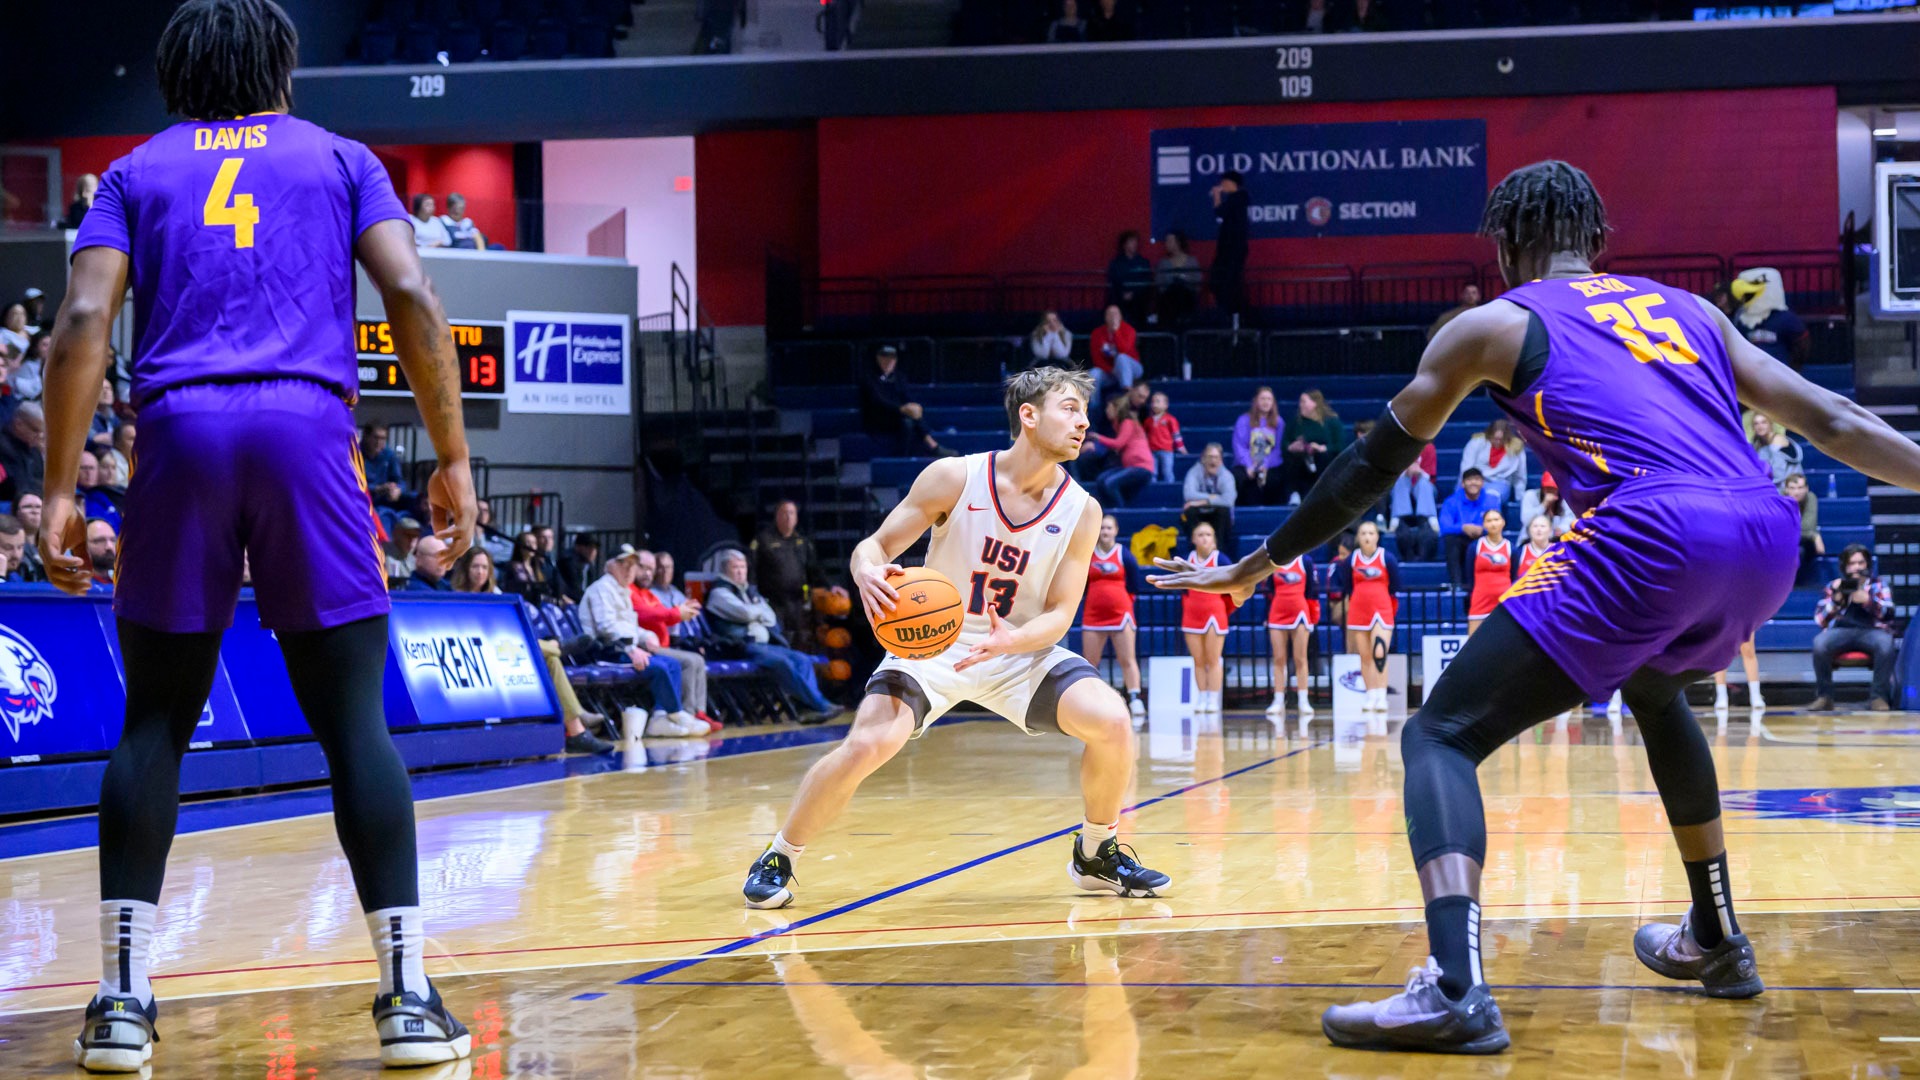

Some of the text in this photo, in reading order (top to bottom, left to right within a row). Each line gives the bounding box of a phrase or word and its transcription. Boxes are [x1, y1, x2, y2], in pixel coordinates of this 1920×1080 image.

[1276, 47, 1312, 69] 209
[410, 74, 445, 97] 209
[1279, 75, 1312, 97] 109
[195, 124, 268, 150] DAVIS
[1260, 149, 1394, 173] NATIONAL
[1402, 146, 1475, 169] BANK
[204, 157, 259, 248] 4
[1248, 202, 1416, 222] DENT SECTION
[359, 322, 395, 354] 1:5
[1585, 292, 1700, 364] 35
[572, 347, 621, 366] Express
[388, 364, 397, 384] 1
[470, 354, 497, 386] 13
[521, 392, 540, 404] AN
[574, 393, 615, 406] HOTEL
[981, 535, 1031, 576] USI
[967, 570, 1019, 618] 13
[895, 619, 956, 642] Wilson
[401, 637, 492, 688] Kenny KENT
